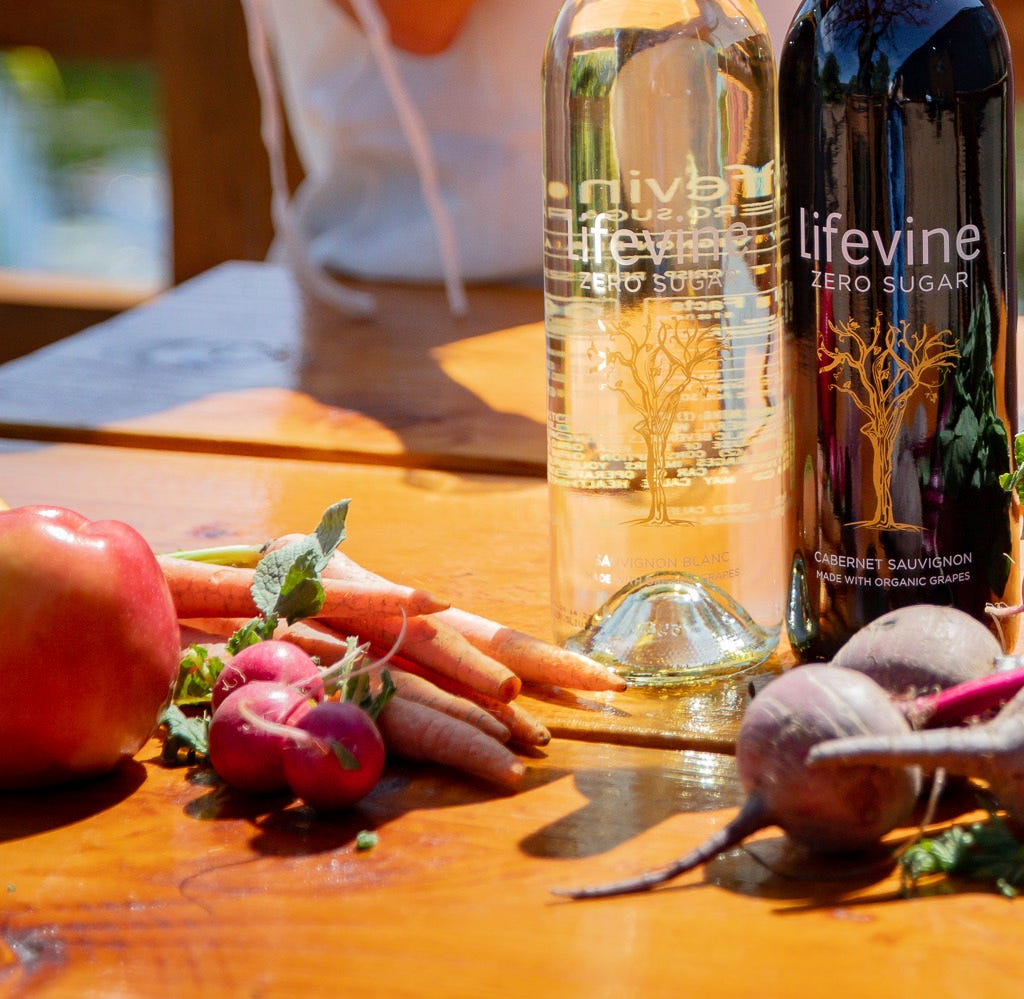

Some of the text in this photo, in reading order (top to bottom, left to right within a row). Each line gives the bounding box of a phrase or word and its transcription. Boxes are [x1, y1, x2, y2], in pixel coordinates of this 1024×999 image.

[800, 207, 981, 266] lifevine
[580, 271, 642, 293] ZERO
[653, 270, 738, 293] SUGAR
[811, 270, 969, 293] ZERO SUGAR
[683, 551, 730, 568] BLANC
[814, 551, 973, 570] CABERNET SAUVIGNON
[816, 570, 971, 587] MADE WITH ORGANIC GRAPES
